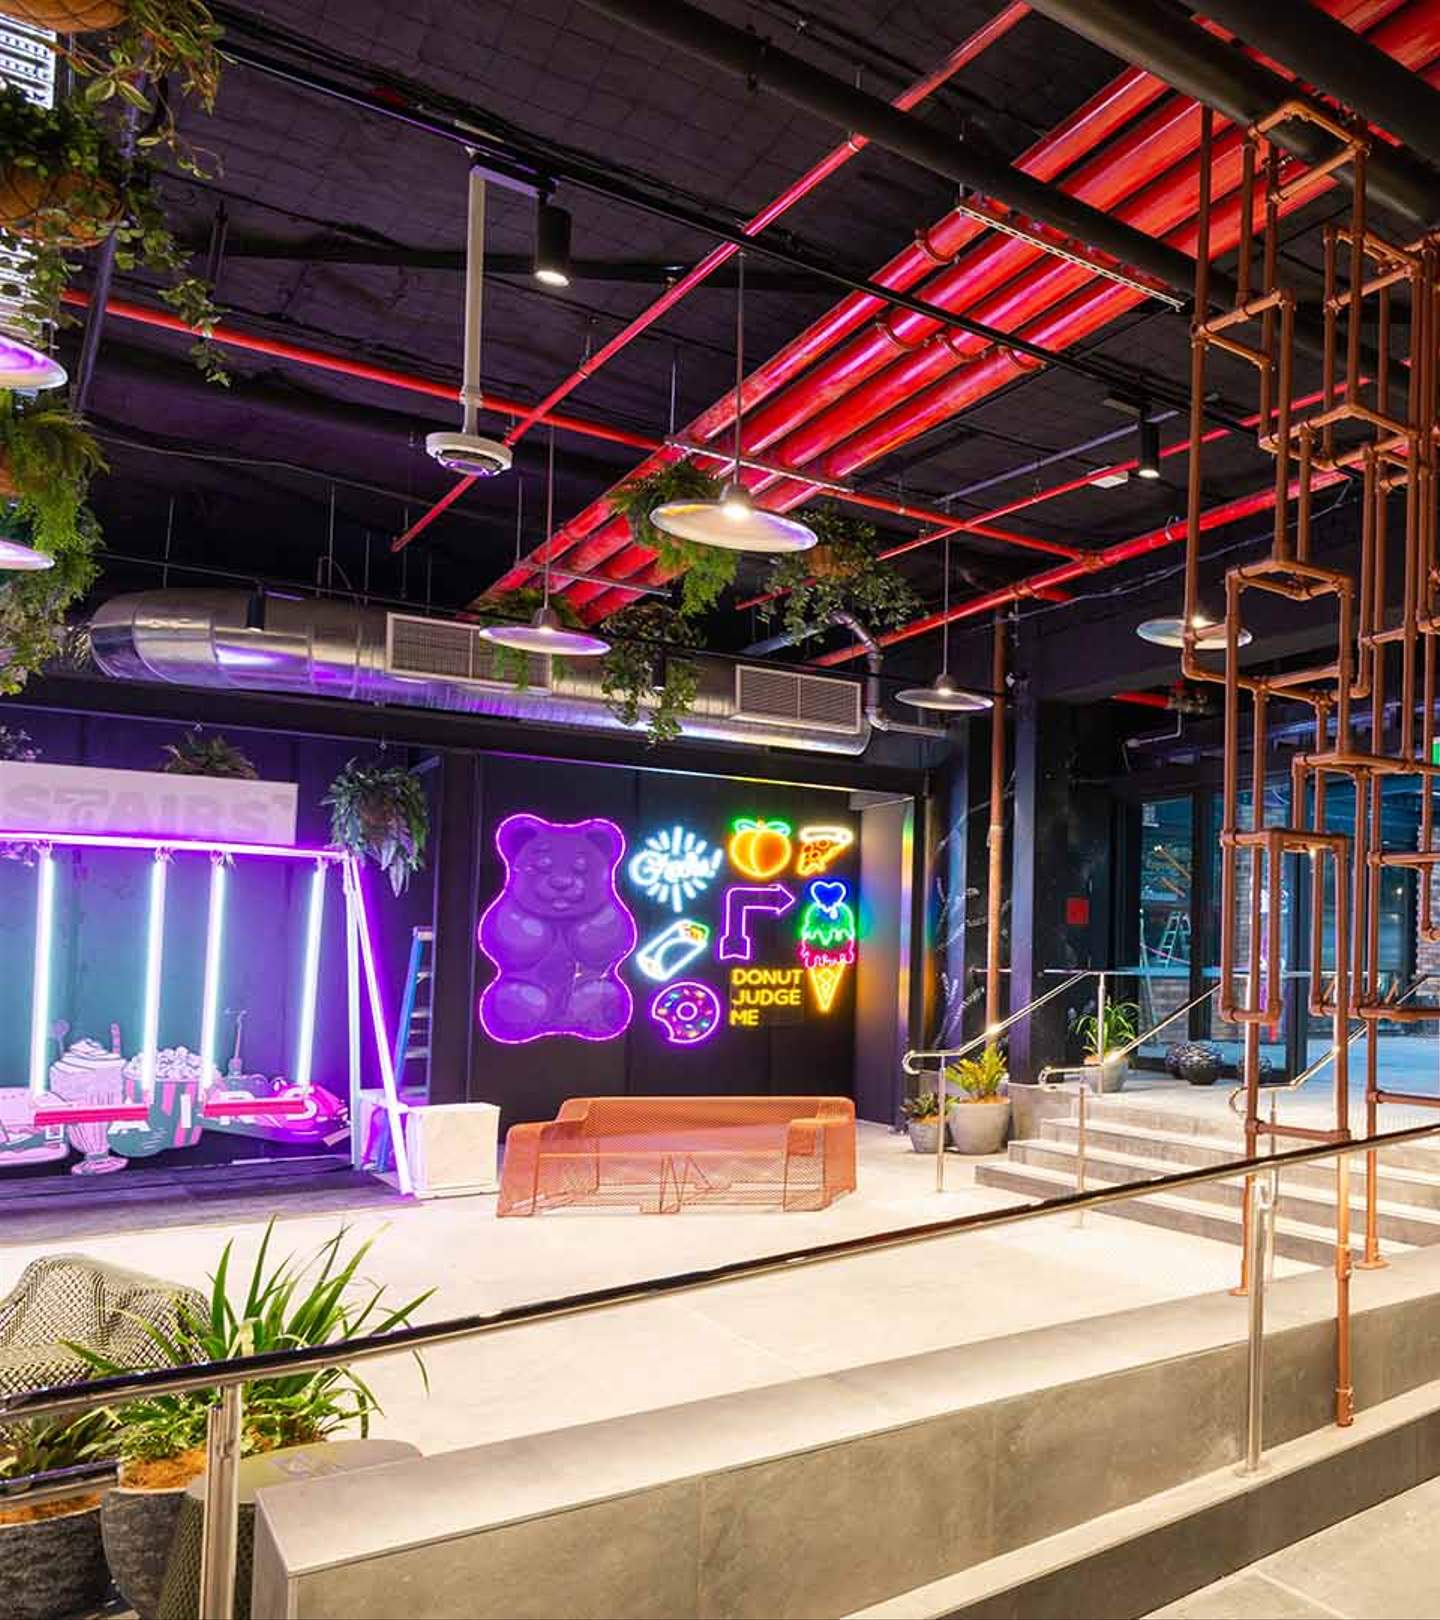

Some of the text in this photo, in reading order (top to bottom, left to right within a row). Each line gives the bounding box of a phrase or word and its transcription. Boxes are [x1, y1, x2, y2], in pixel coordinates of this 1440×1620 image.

[731, 968, 804, 985] DONUT
[731, 988, 801, 1006] JUDGE
[730, 1009, 759, 1026] ME
